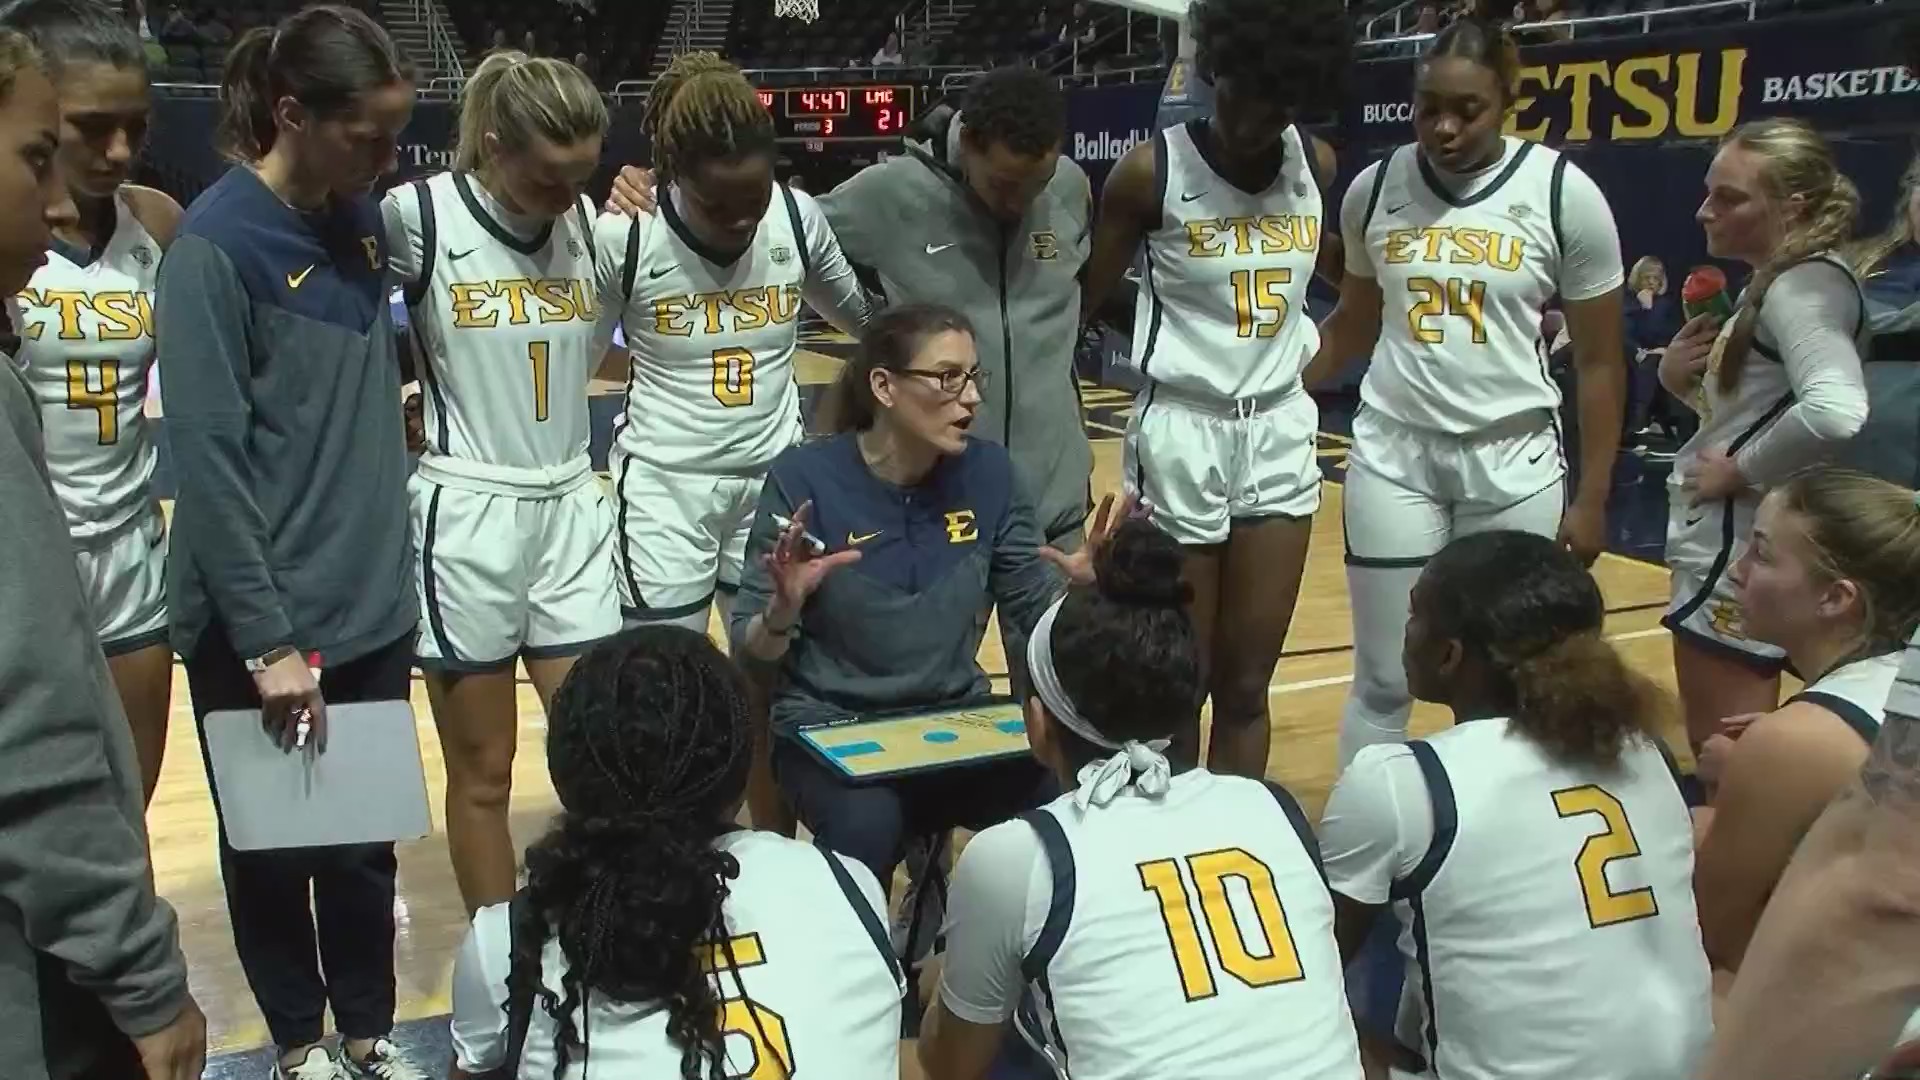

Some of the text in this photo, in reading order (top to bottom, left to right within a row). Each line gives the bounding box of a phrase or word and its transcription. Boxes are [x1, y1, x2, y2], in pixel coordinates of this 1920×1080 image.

[801, 91, 846, 110] 4:47
[865, 89, 894, 104] LMC
[823, 119, 833, 134] 3
[877, 109, 904, 130] 21
[1184, 214, 1318, 257] ETSU
[1385, 226, 1526, 272] ETSU
[449, 277, 599, 329] ETSU
[653, 284, 800, 338] ETSU
[1230, 267, 1292, 338] 15
[1407, 276, 1487, 344] 24
[66, 360, 120, 445] 4
[528, 341, 549, 422] 1
[712, 346, 755, 408] 0
[944, 509, 979, 544] E
[1549, 784, 1660, 929] 2
[1135, 847, 1306, 1003] 10
